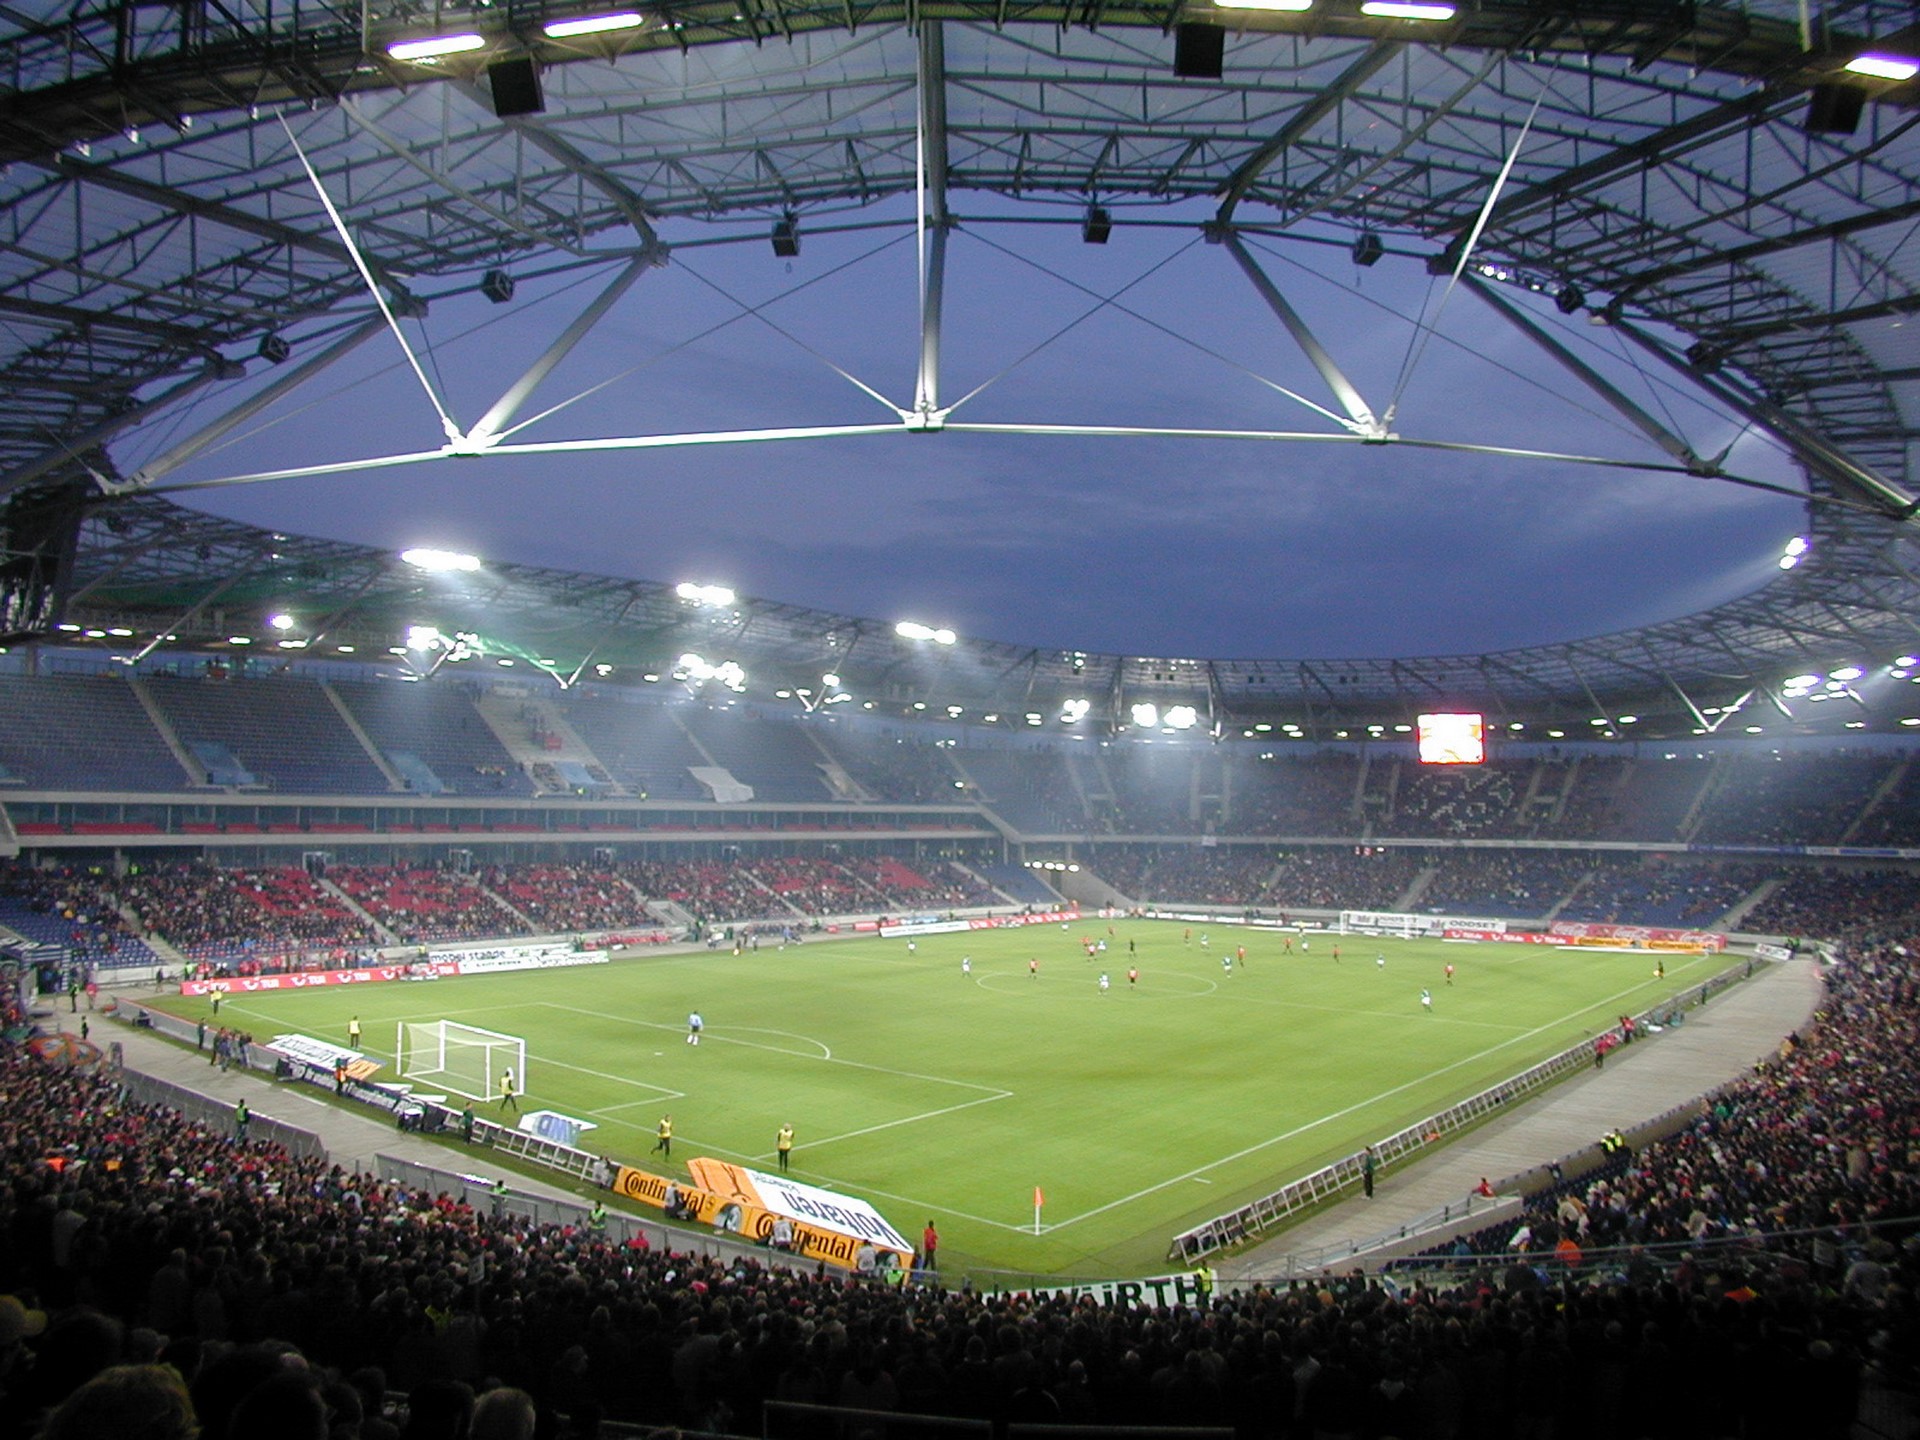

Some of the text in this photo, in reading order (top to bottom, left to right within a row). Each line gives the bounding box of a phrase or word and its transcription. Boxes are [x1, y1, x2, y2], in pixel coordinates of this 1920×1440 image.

[1450, 919, 1496, 929] ODDSET
[624, 1170, 706, 1214] Contintal
[756, 1212, 855, 1260] Coinental
[780, 1191, 910, 1250] Voltaren
